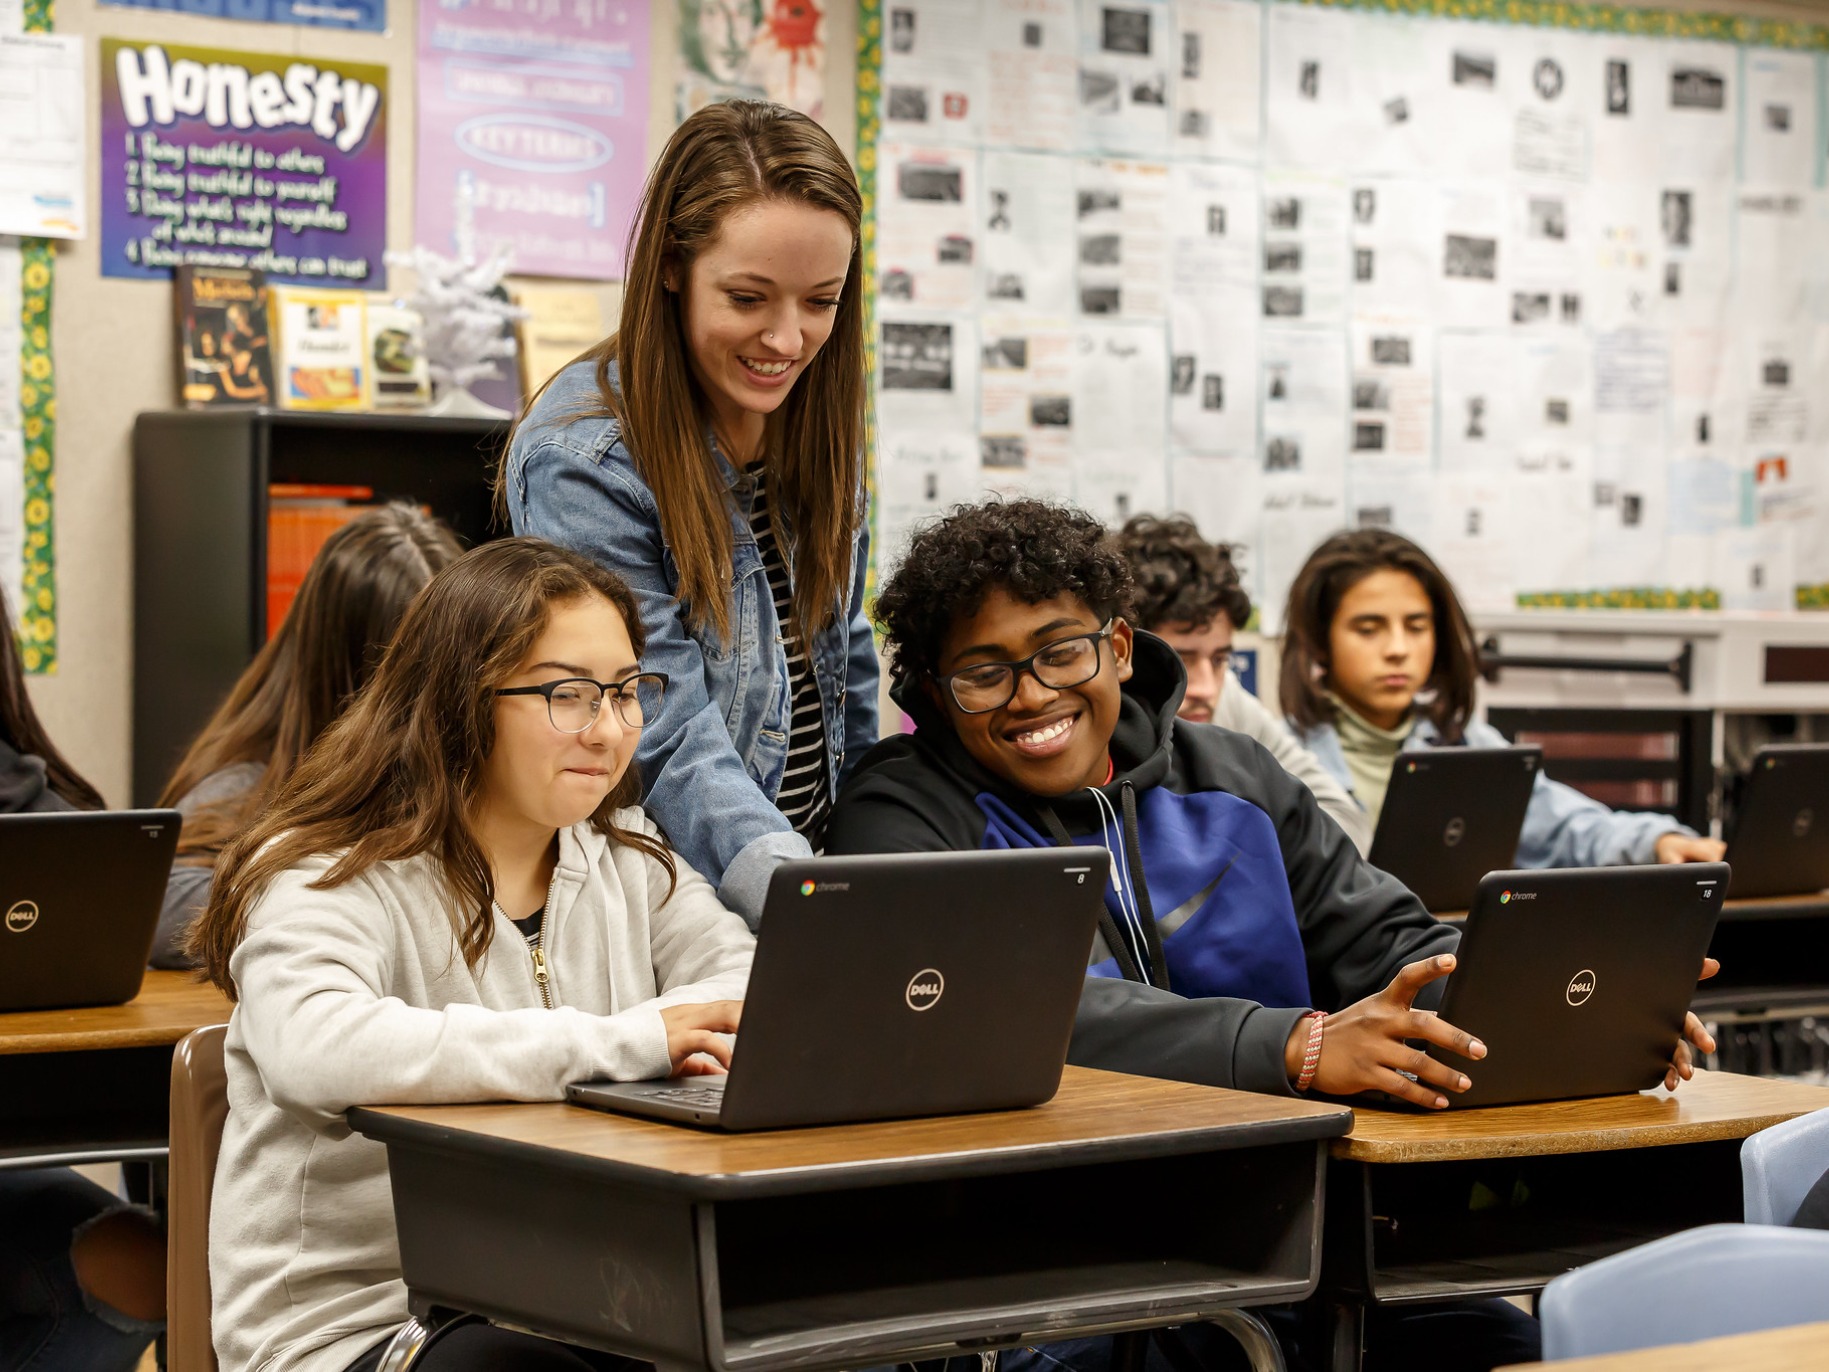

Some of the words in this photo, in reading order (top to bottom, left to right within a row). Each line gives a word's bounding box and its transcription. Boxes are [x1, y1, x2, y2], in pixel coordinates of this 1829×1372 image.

[116, 45, 379, 152] Honesty
[187, 141, 253, 168] truthful
[254, 147, 275, 169] to
[275, 146, 326, 175] others
[187, 169, 253, 197] truthful
[254, 175, 275, 197] to
[276, 176, 338, 204] yourself
[1077, 873, 1085, 884] 8
[816, 882, 850, 892] chrome
[1511, 891, 1537, 900] chrome
[910, 983, 939, 996] DELL
[1569, 982, 1591, 993] DELL
